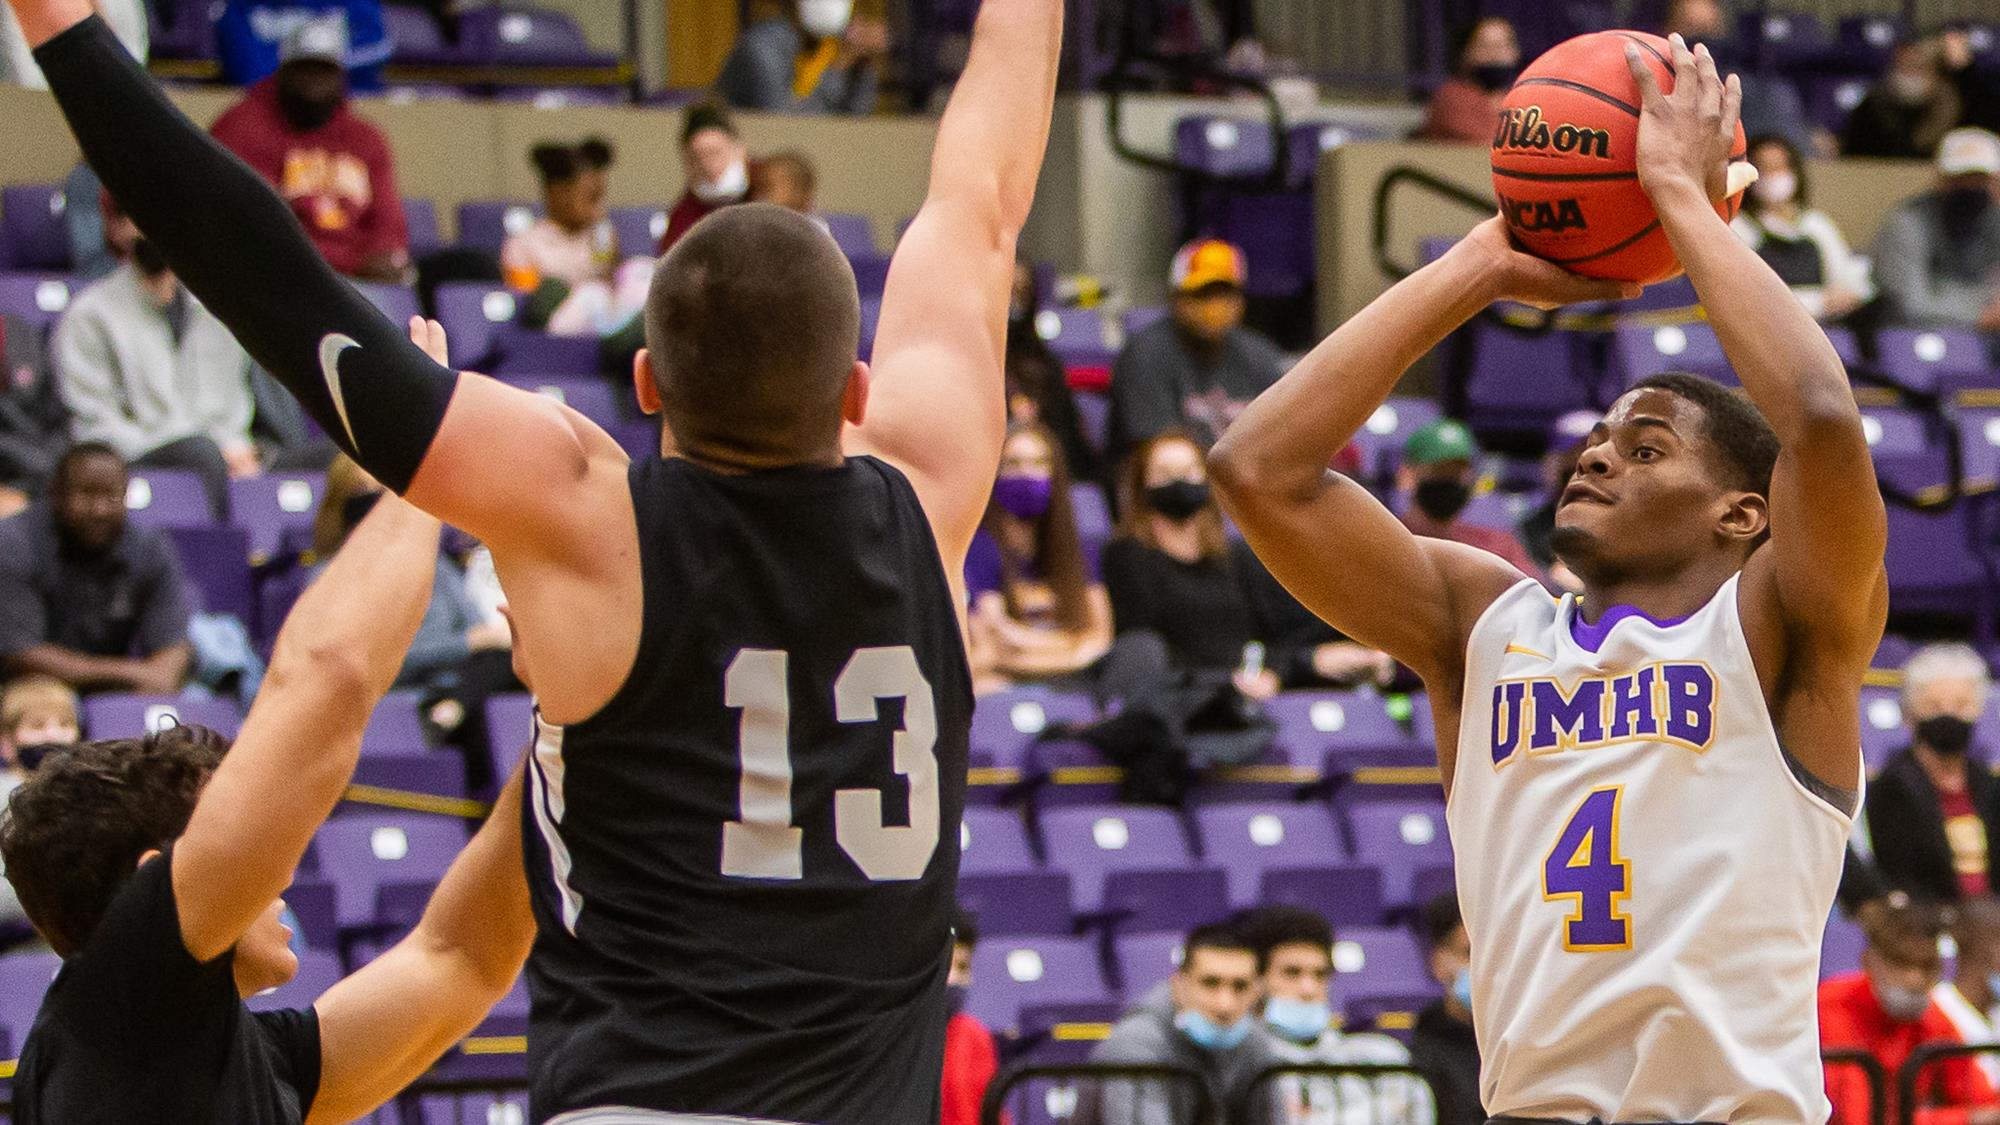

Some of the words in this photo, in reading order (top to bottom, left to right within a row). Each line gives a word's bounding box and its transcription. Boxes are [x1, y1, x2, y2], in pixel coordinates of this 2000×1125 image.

[721, 645, 940, 881] 13
[1489, 660, 1719, 774] UMHB
[1541, 783, 1633, 952] 4
